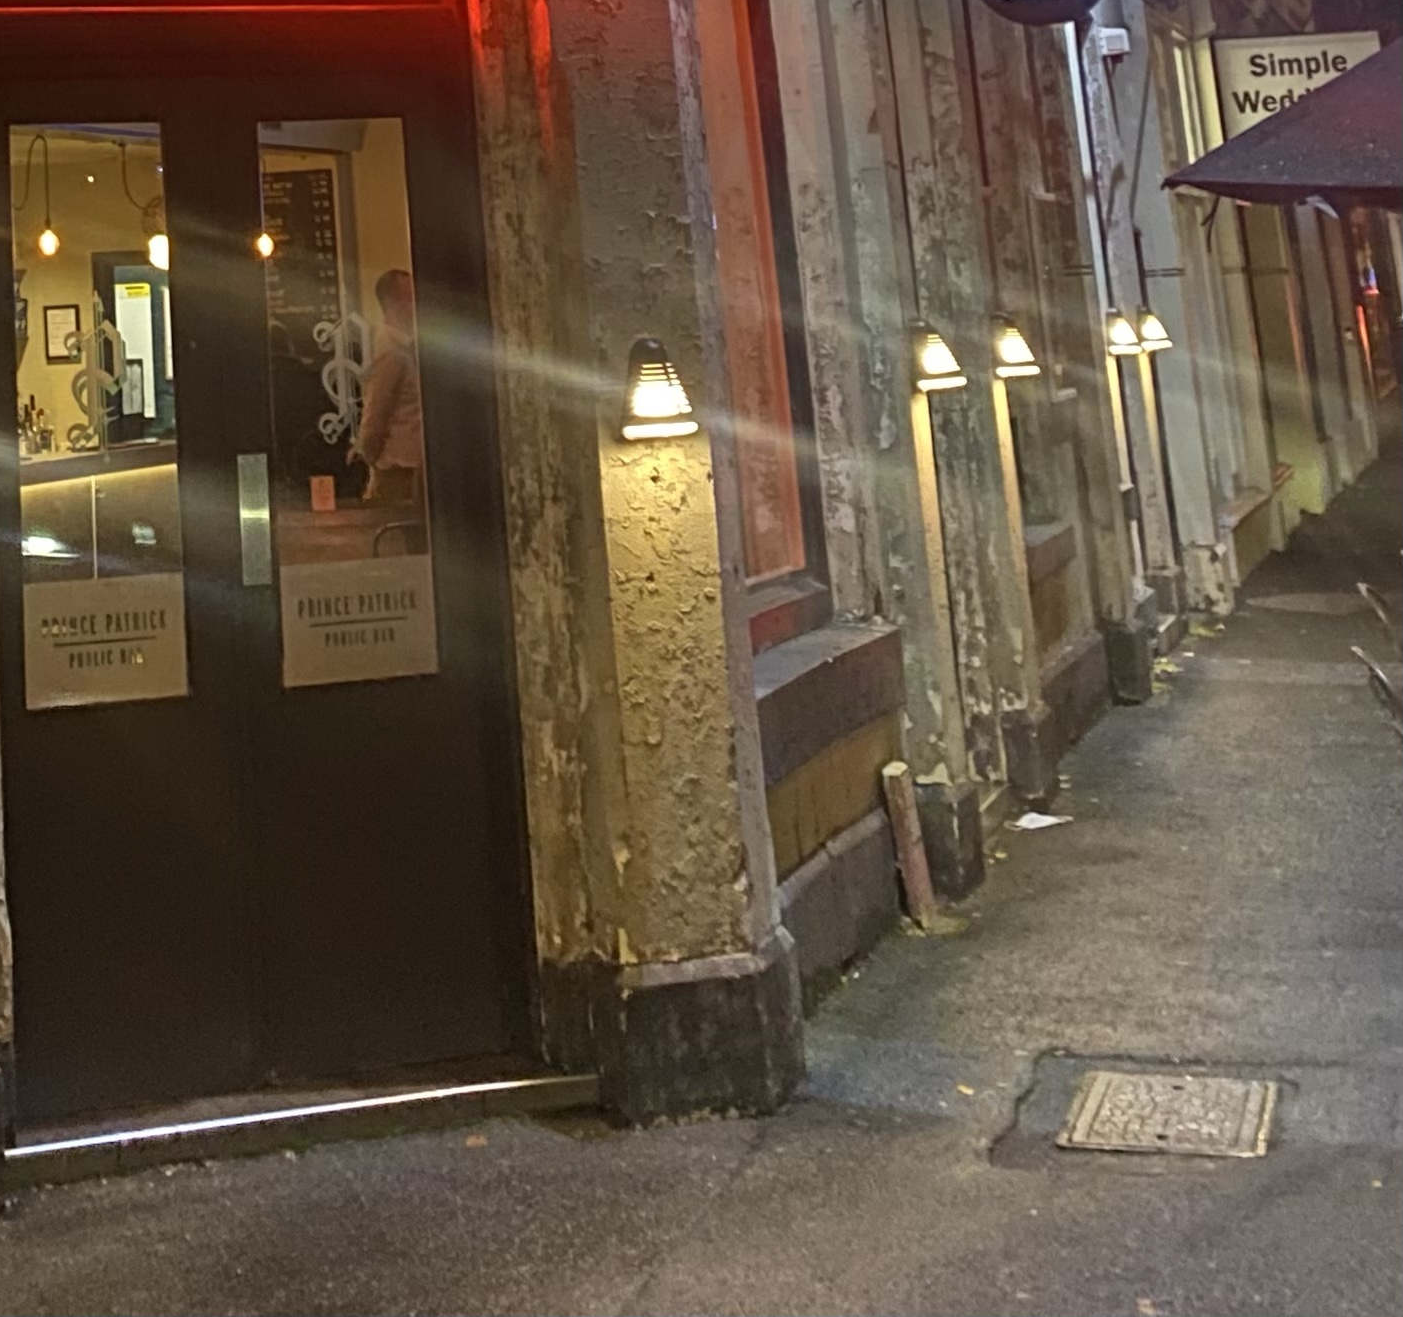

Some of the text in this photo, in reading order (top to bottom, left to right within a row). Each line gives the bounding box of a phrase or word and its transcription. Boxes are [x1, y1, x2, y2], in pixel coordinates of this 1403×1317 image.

[1249, 50, 1348, 80] Simple
[298, 590, 417, 619] PRINCE PATRICK
[106, 610, 166, 633] PATRICK
